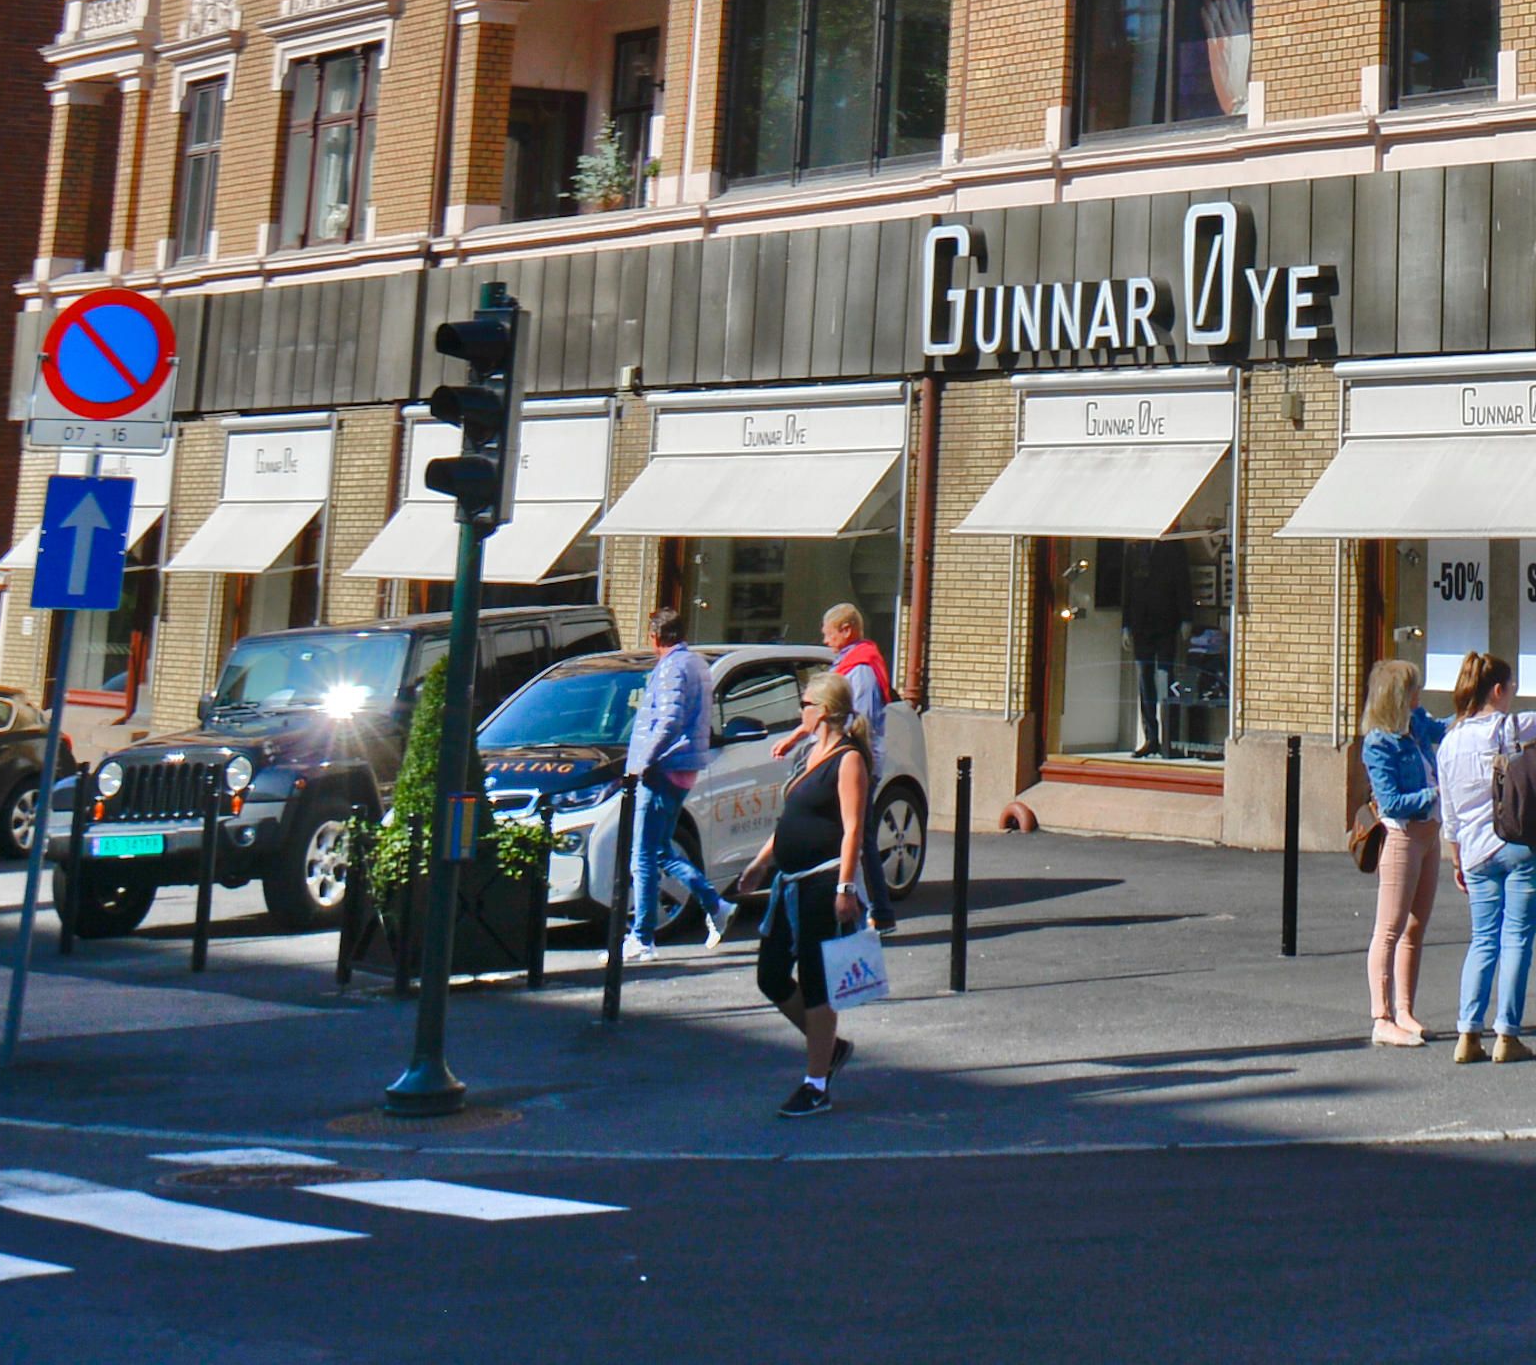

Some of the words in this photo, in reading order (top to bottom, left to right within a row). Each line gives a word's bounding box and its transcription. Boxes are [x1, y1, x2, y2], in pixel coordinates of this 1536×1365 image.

[922, 224, 1159, 357] GUNNAR
[1183, 201, 1320, 346] ØYE
[1085, 401, 1135, 437] GUNNAR
[1138, 400, 1165, 436] ØYE
[1461, 387, 1524, 427] GUNNAR
[64, 426, 85, 443] 07
[111, 427, 128, 443] 16
[1433, 561, 1484, 602] -50%
